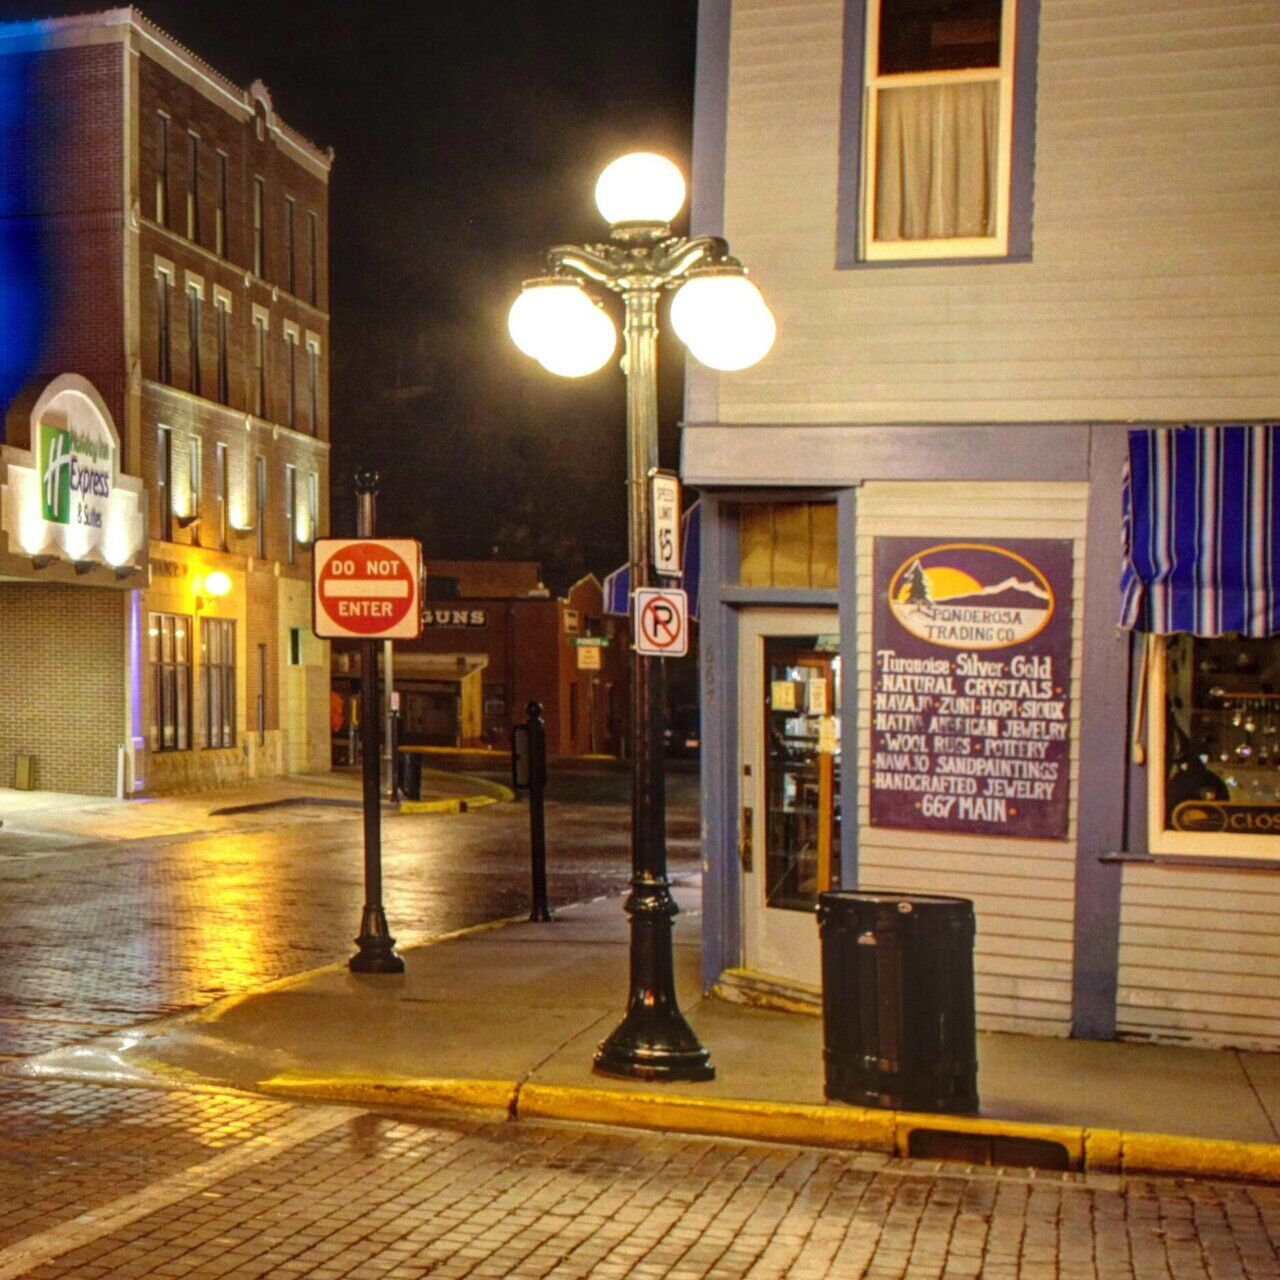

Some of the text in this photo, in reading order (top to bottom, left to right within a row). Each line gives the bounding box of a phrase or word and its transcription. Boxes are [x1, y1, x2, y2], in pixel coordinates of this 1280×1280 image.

[71, 426, 97, 464] Holiday
[70, 454, 109, 500] Express
[83, 505, 103, 528] Suites
[659, 528, 673, 562] 15
[332, 560, 400, 575] DO NOT
[338, 601, 393, 617] ENTER
[932, 607, 1023, 625] PONDEROSA
[925, 624, 993, 641] TRADING
[877, 650, 1052, 679] Turquoise Silver Gold
[881, 675, 1053, 699] NATURAL CRYSTALS
[938, 697, 975, 715] ZUNI
[981, 699, 1017, 718] HOPI
[1021, 701, 1064, 719] SIOUX
[1002, 720, 1067, 740] JEWELRY
[885, 733, 928, 752] WOOL
[984, 739, 1049, 759] POTTERY
[875, 753, 1058, 780] NAVAJO SANDPAINTINGS
[875, 772, 1055, 800] HANDCRAFTED JEWELRY
[922, 795, 1006, 822] 667 MAIN
